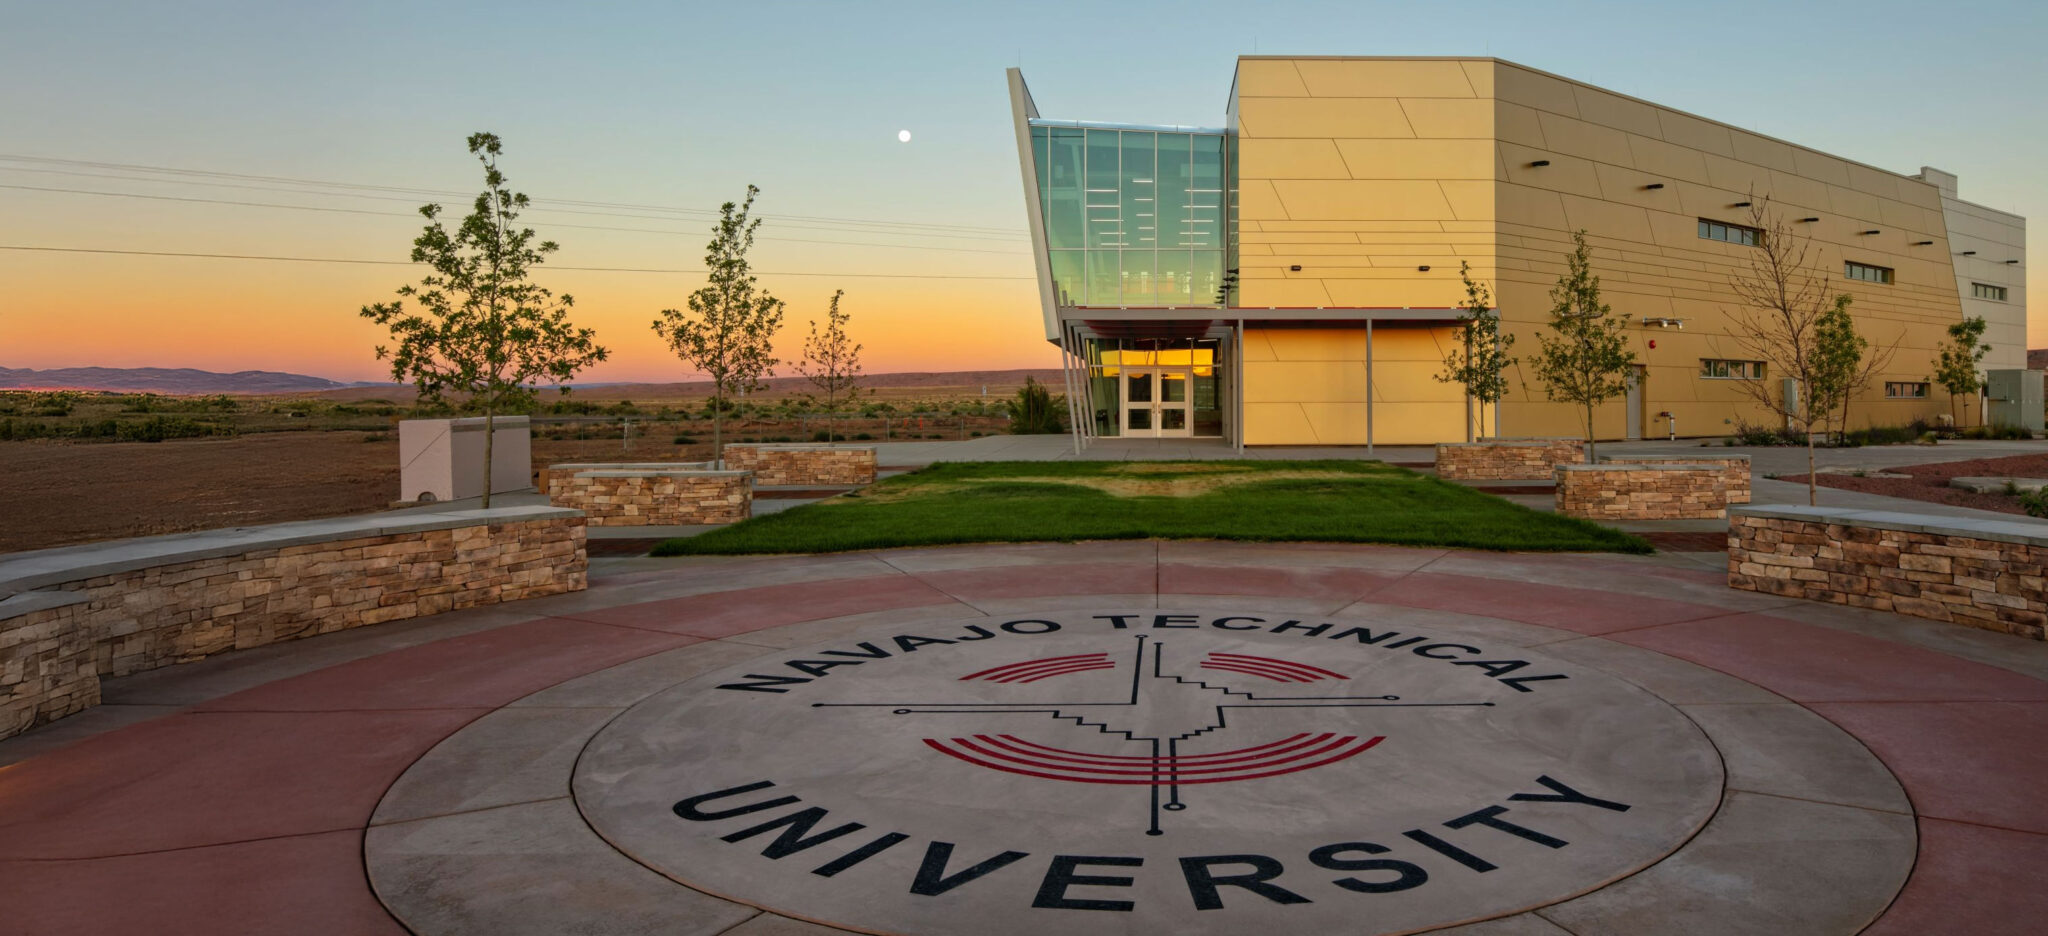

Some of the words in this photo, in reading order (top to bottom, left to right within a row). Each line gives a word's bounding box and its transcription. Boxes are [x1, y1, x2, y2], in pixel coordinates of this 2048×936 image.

[716, 619, 1062, 694] NAVAJO
[1092, 614, 1570, 693] TECHNICAL
[671, 774, 1633, 913] UNIVERSITY
